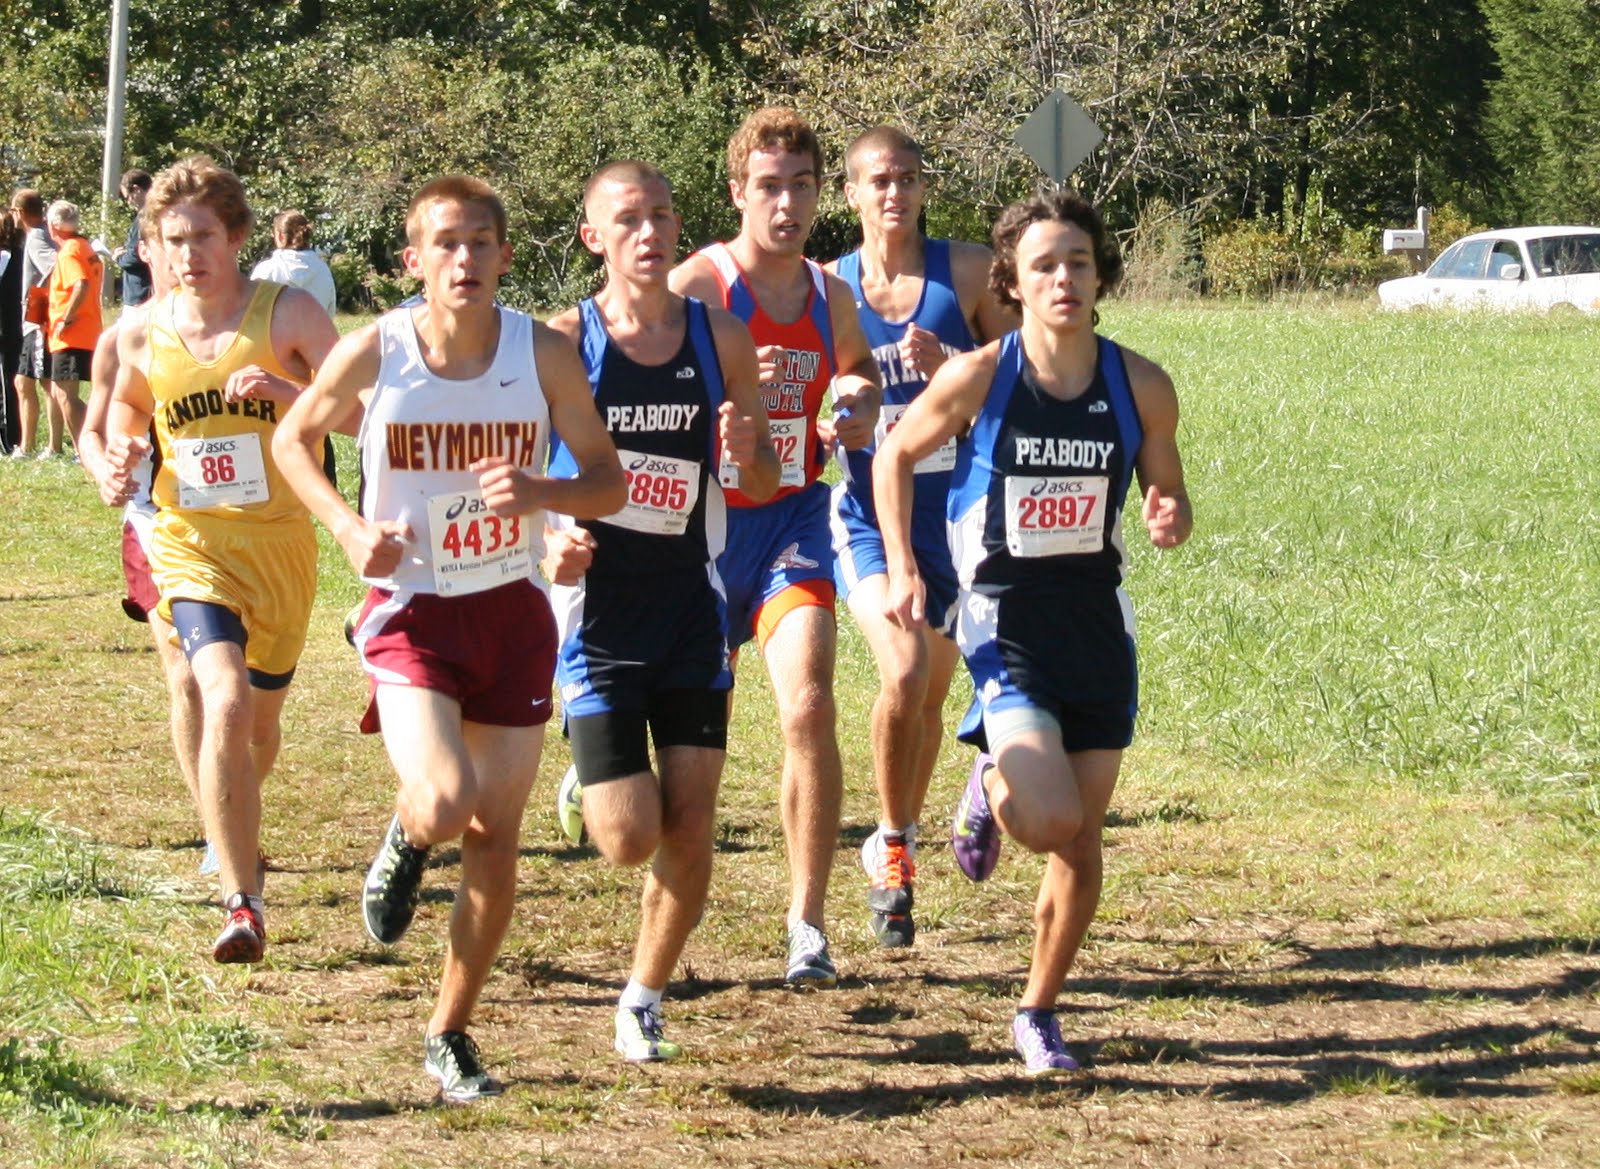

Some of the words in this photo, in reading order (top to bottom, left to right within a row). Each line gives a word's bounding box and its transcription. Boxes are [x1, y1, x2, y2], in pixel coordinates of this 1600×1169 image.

[165, 389, 277, 434] ANDOVER
[606, 404, 700, 432] PEABODY
[386, 421, 538, 471] WEYMOUTH
[1015, 437, 1115, 470] PEABODY
[201, 455, 236, 485] 86
[1018, 495, 1098, 529] 2897
[442, 515, 520, 559] 4433
